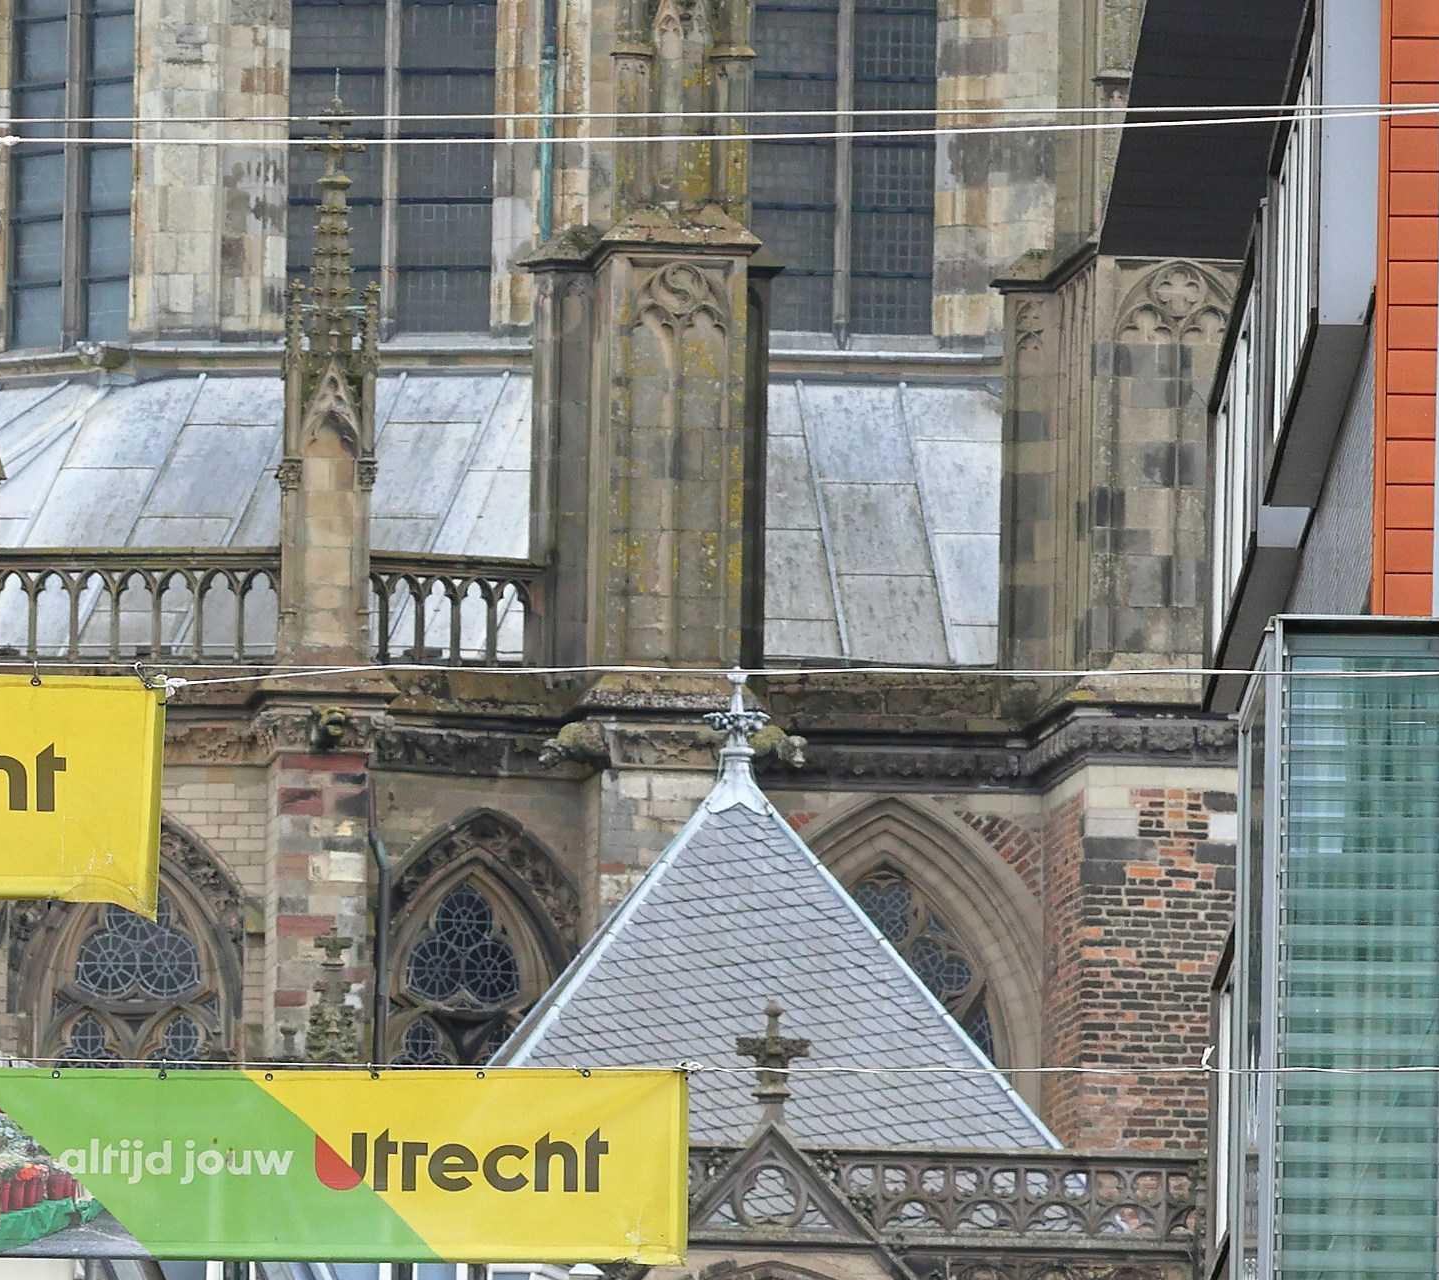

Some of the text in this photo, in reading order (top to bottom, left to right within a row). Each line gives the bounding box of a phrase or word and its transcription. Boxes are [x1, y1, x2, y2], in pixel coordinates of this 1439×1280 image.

[58, 1138, 295, 1184] altijd jouw
[314, 1127, 610, 1192] Utrecht
